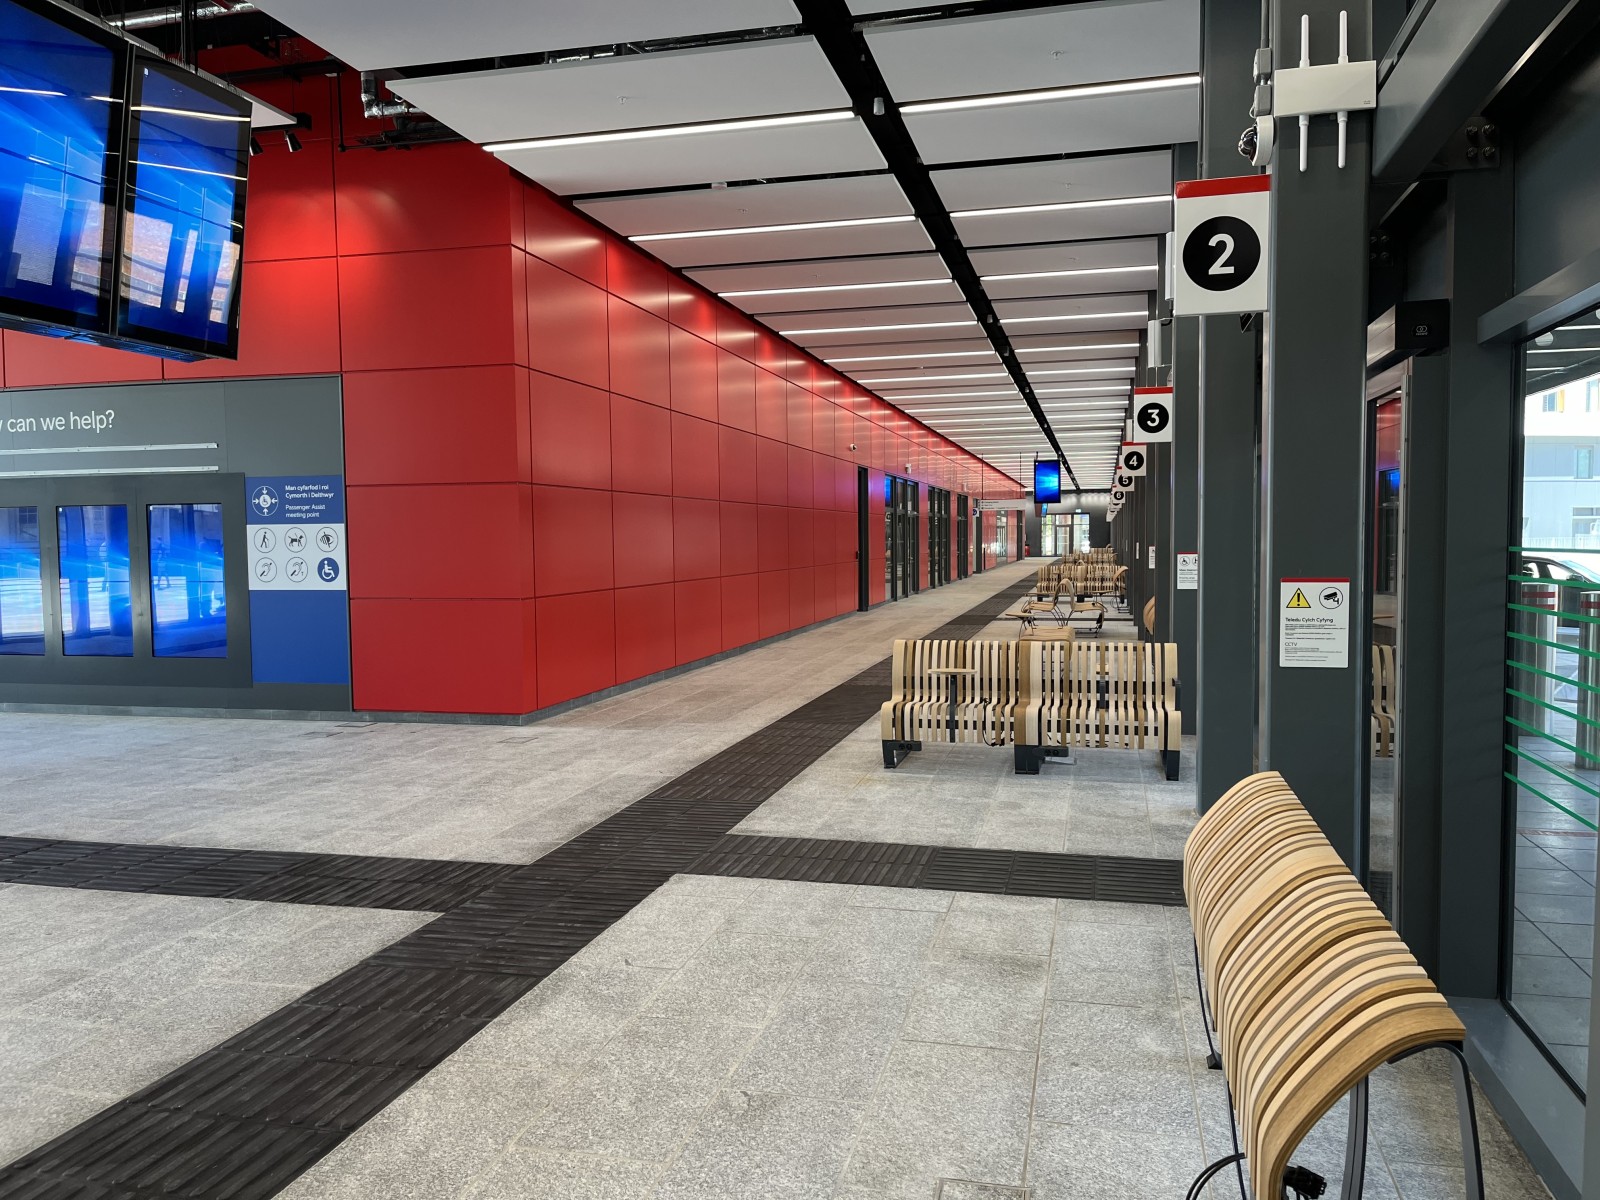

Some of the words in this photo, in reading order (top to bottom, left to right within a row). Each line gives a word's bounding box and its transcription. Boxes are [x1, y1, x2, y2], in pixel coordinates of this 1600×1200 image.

[1208, 233, 1235, 275] 2
[7, 417, 37, 433] can
[40, 416, 66, 431] we
[69, 409, 115, 434] help?
[1146, 409, 1160, 427] 3
[1129, 455, 1138, 467] 4
[1122, 476, 1129, 485] 5
